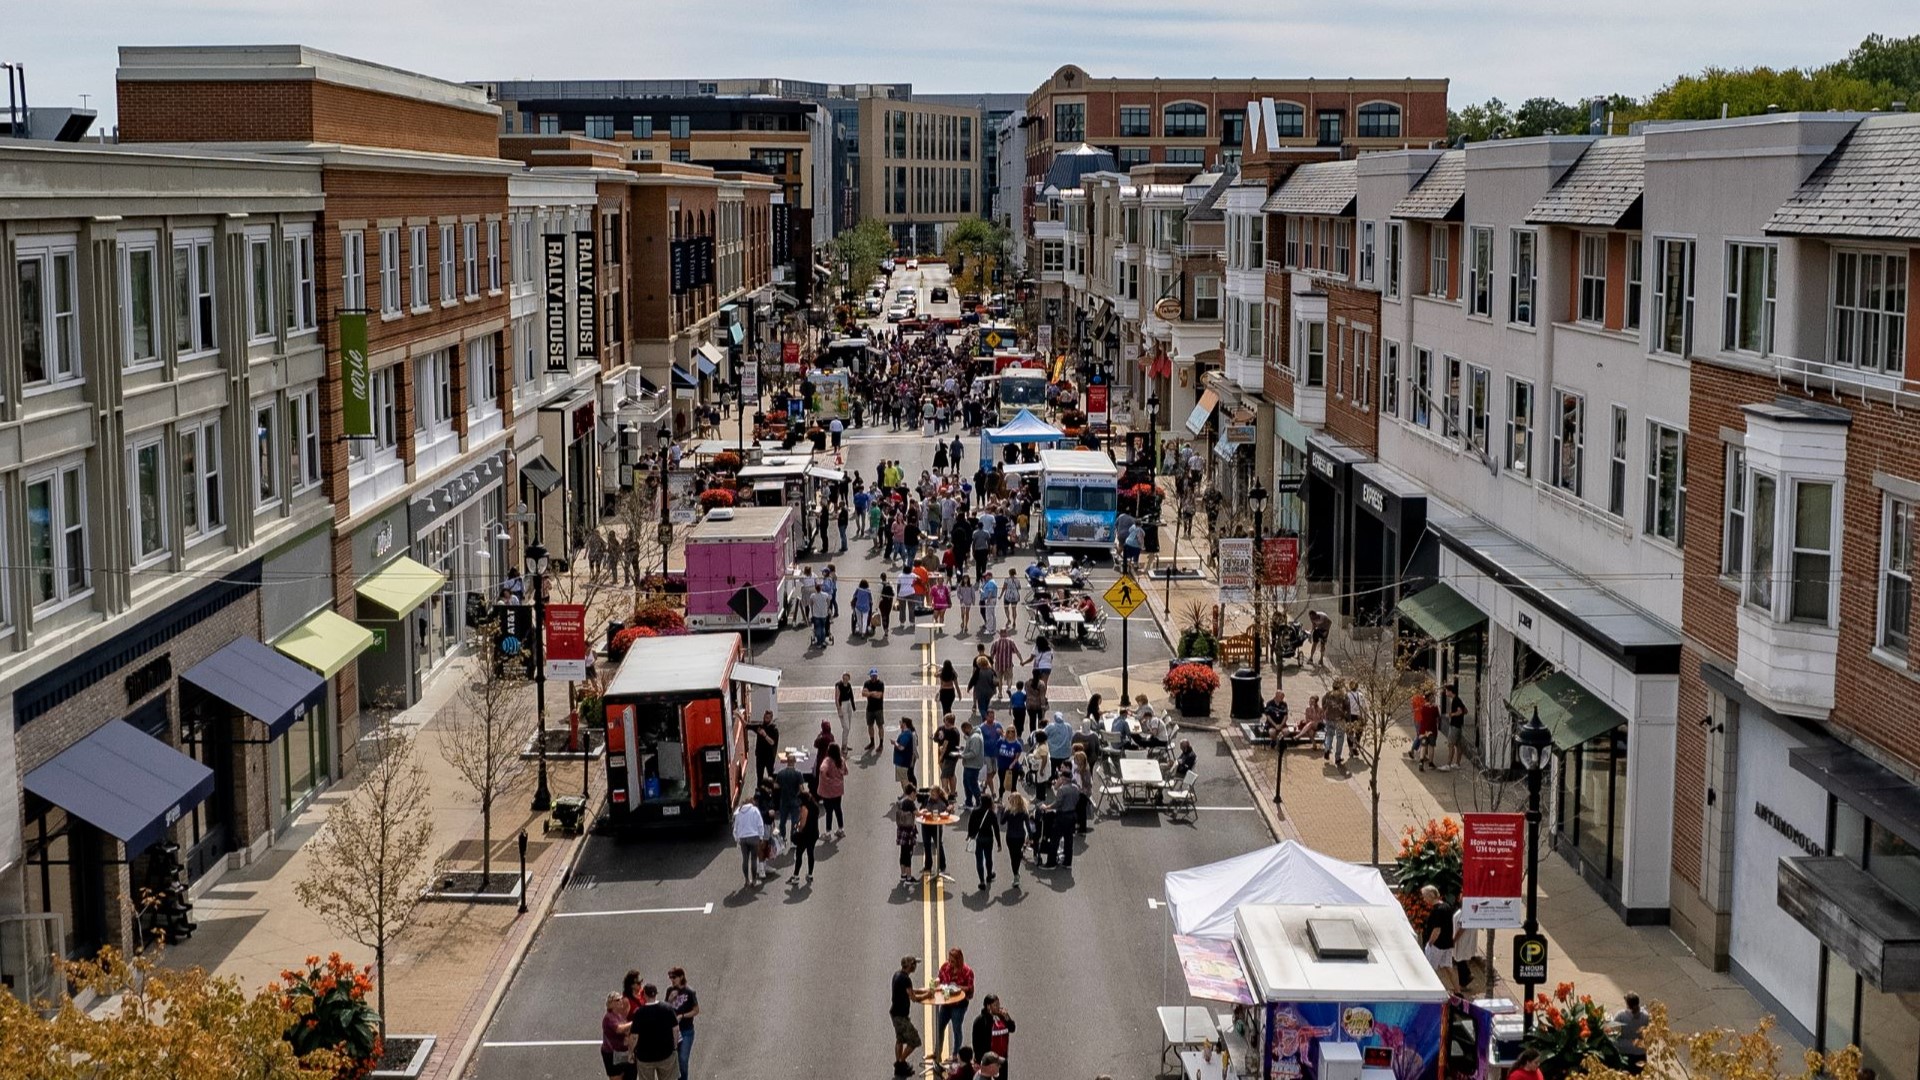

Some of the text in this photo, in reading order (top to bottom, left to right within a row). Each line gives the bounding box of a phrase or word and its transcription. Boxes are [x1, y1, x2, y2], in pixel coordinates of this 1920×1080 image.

[548, 241, 565, 366] RALLY HOUSE
[578, 238, 593, 352] RALLY HOUSE
[344, 349, 366, 400] aerie
[1362, 483, 1383, 512] EXPRESS
[507, 610, 516, 635] AT&T
[1470, 838, 1486, 846] How
[1498, 838, 1517, 847] bring
[1526, 944, 1542, 962] P
